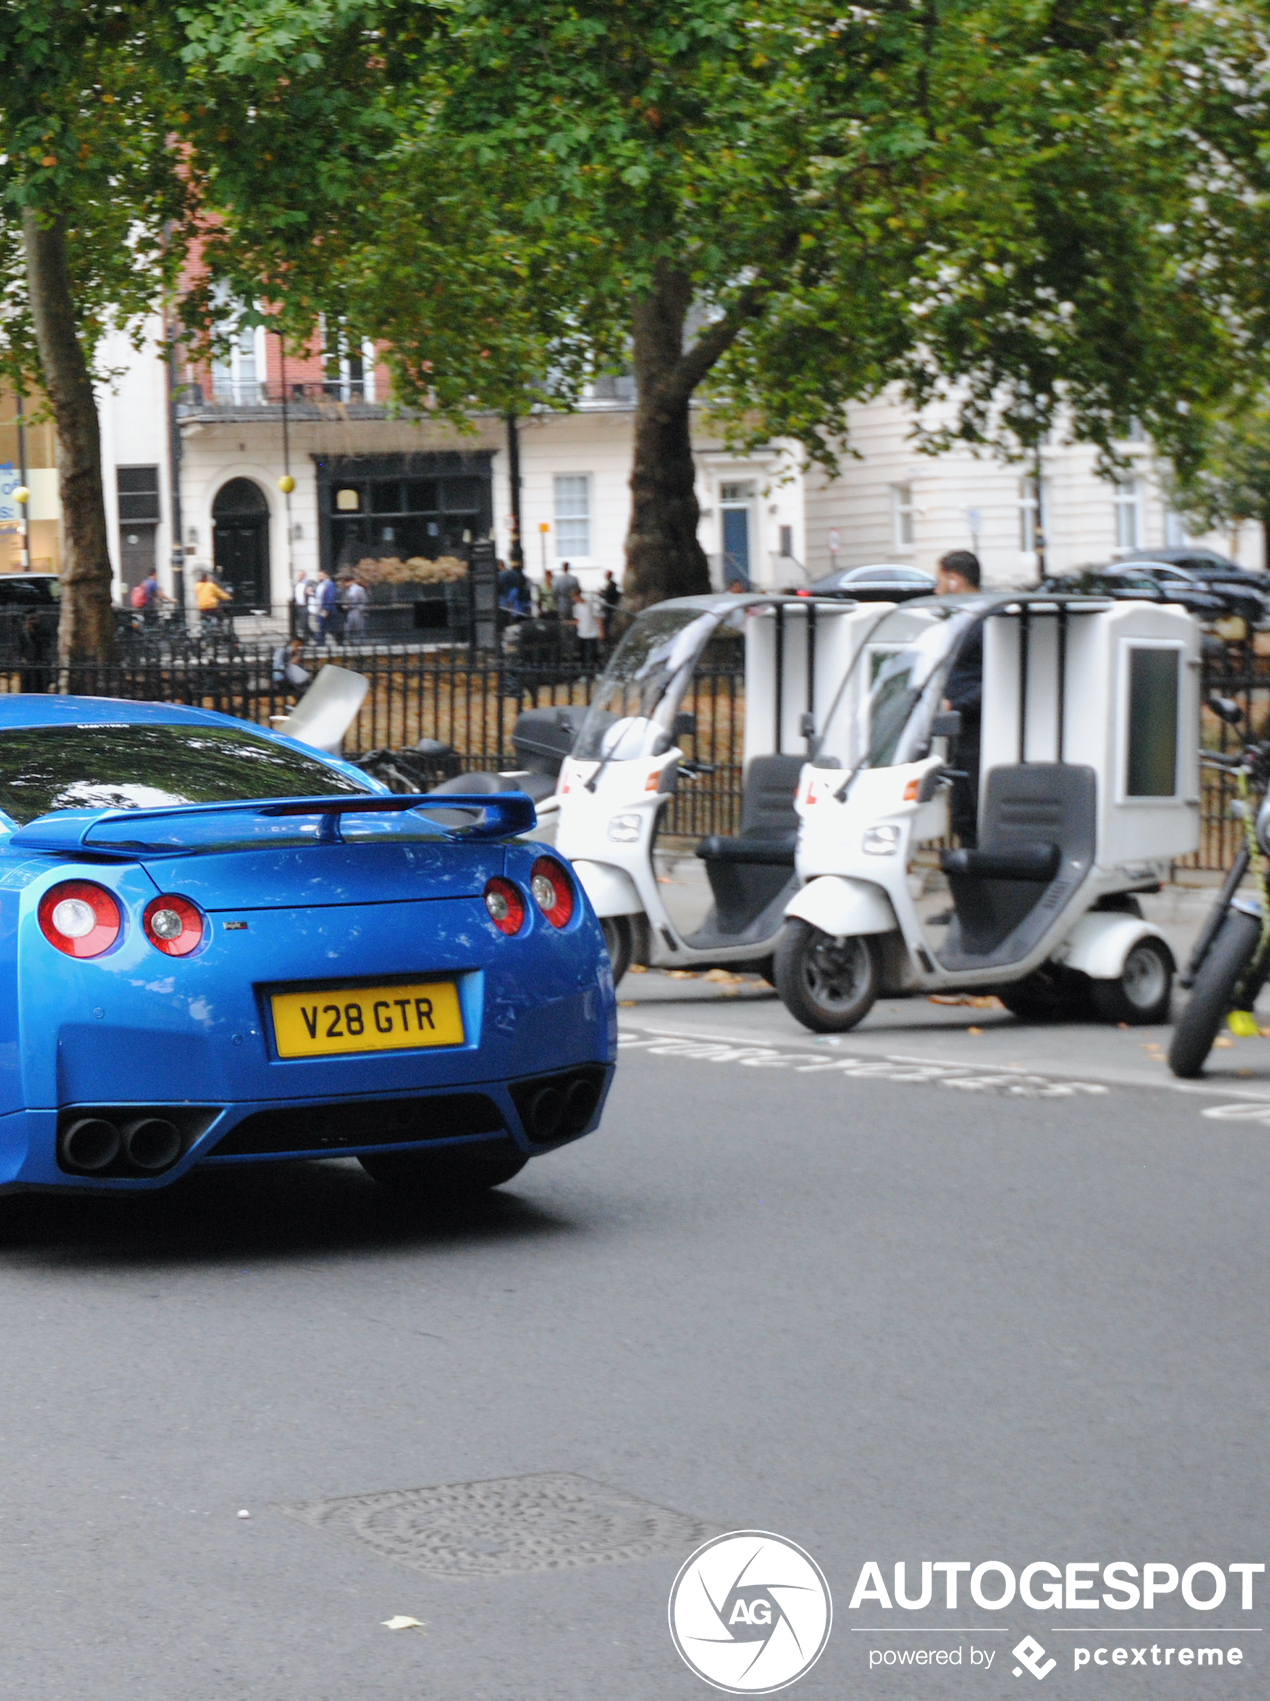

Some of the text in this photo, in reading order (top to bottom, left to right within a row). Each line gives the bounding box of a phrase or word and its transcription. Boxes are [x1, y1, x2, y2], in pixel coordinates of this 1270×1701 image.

[300, 998, 437, 1040] V28 GTR
[618, 1033, 1109, 1098] TORCYCLES
